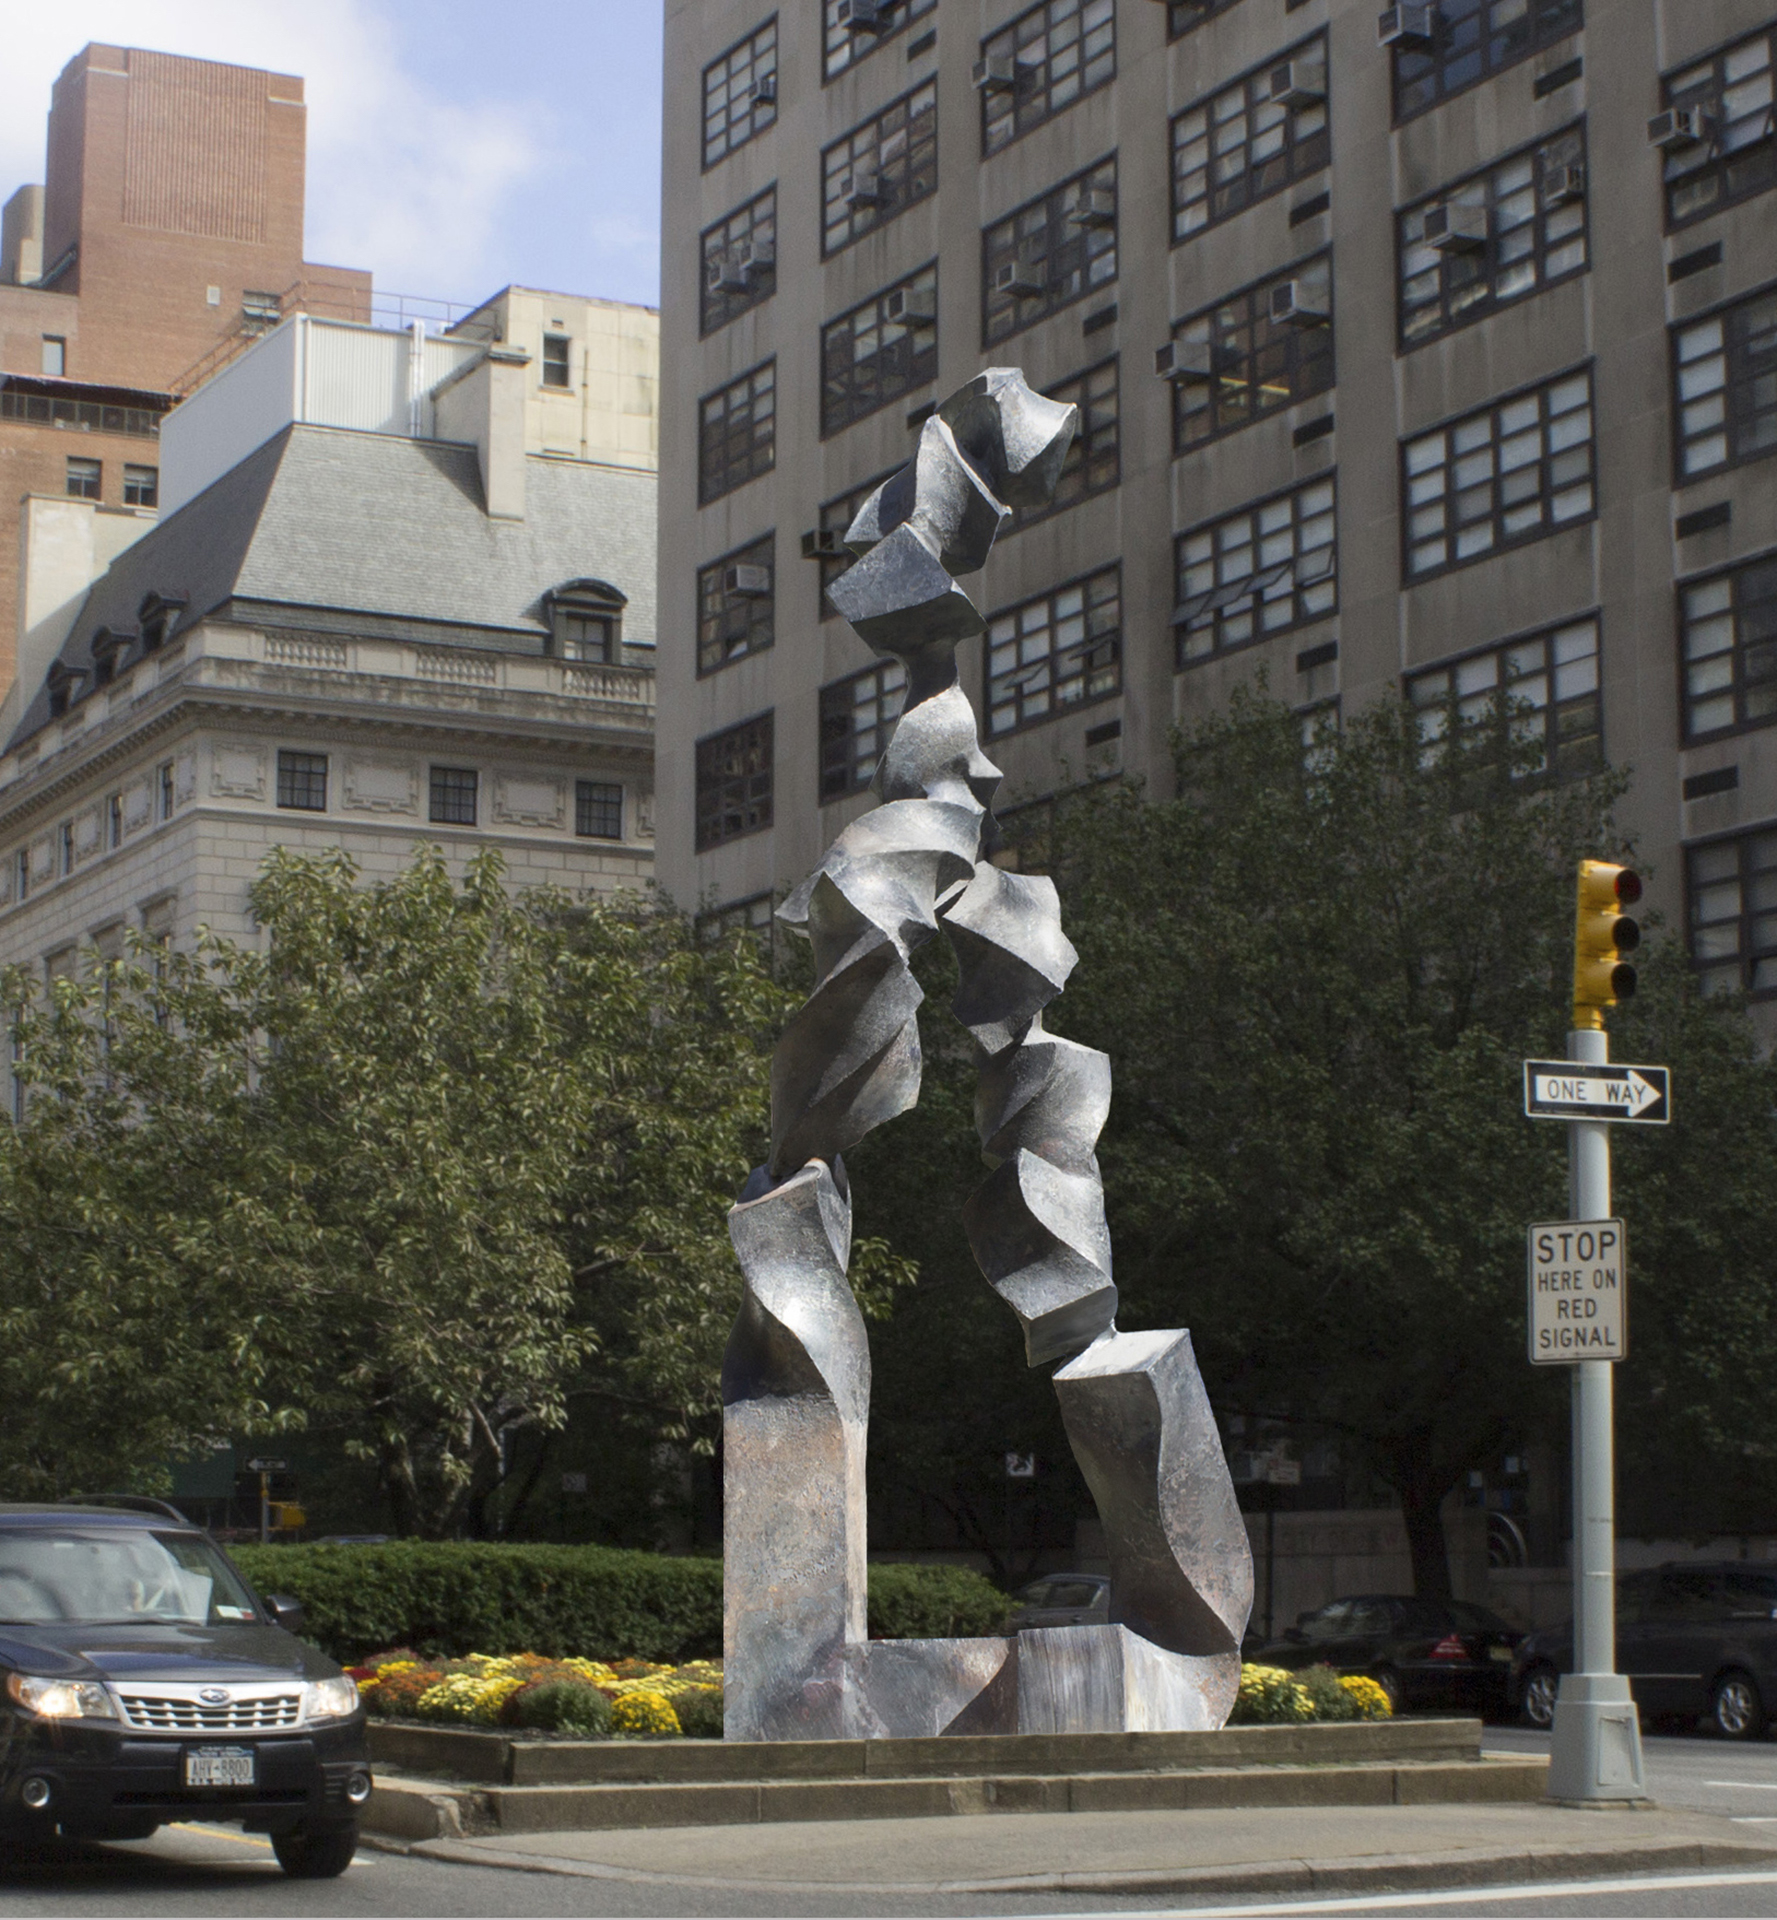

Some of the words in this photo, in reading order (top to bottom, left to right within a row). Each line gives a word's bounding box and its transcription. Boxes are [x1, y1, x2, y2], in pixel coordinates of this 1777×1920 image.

[1547, 1079, 1588, 1101] ONE
[1606, 1083, 1646, 1104] WAY
[1537, 1230, 1617, 1264] STOP
[1538, 1269, 1583, 1293] HERE
[1593, 1268, 1617, 1290] ON
[1557, 1297, 1597, 1320] RED
[1539, 1325, 1617, 1350] SIGNAL
